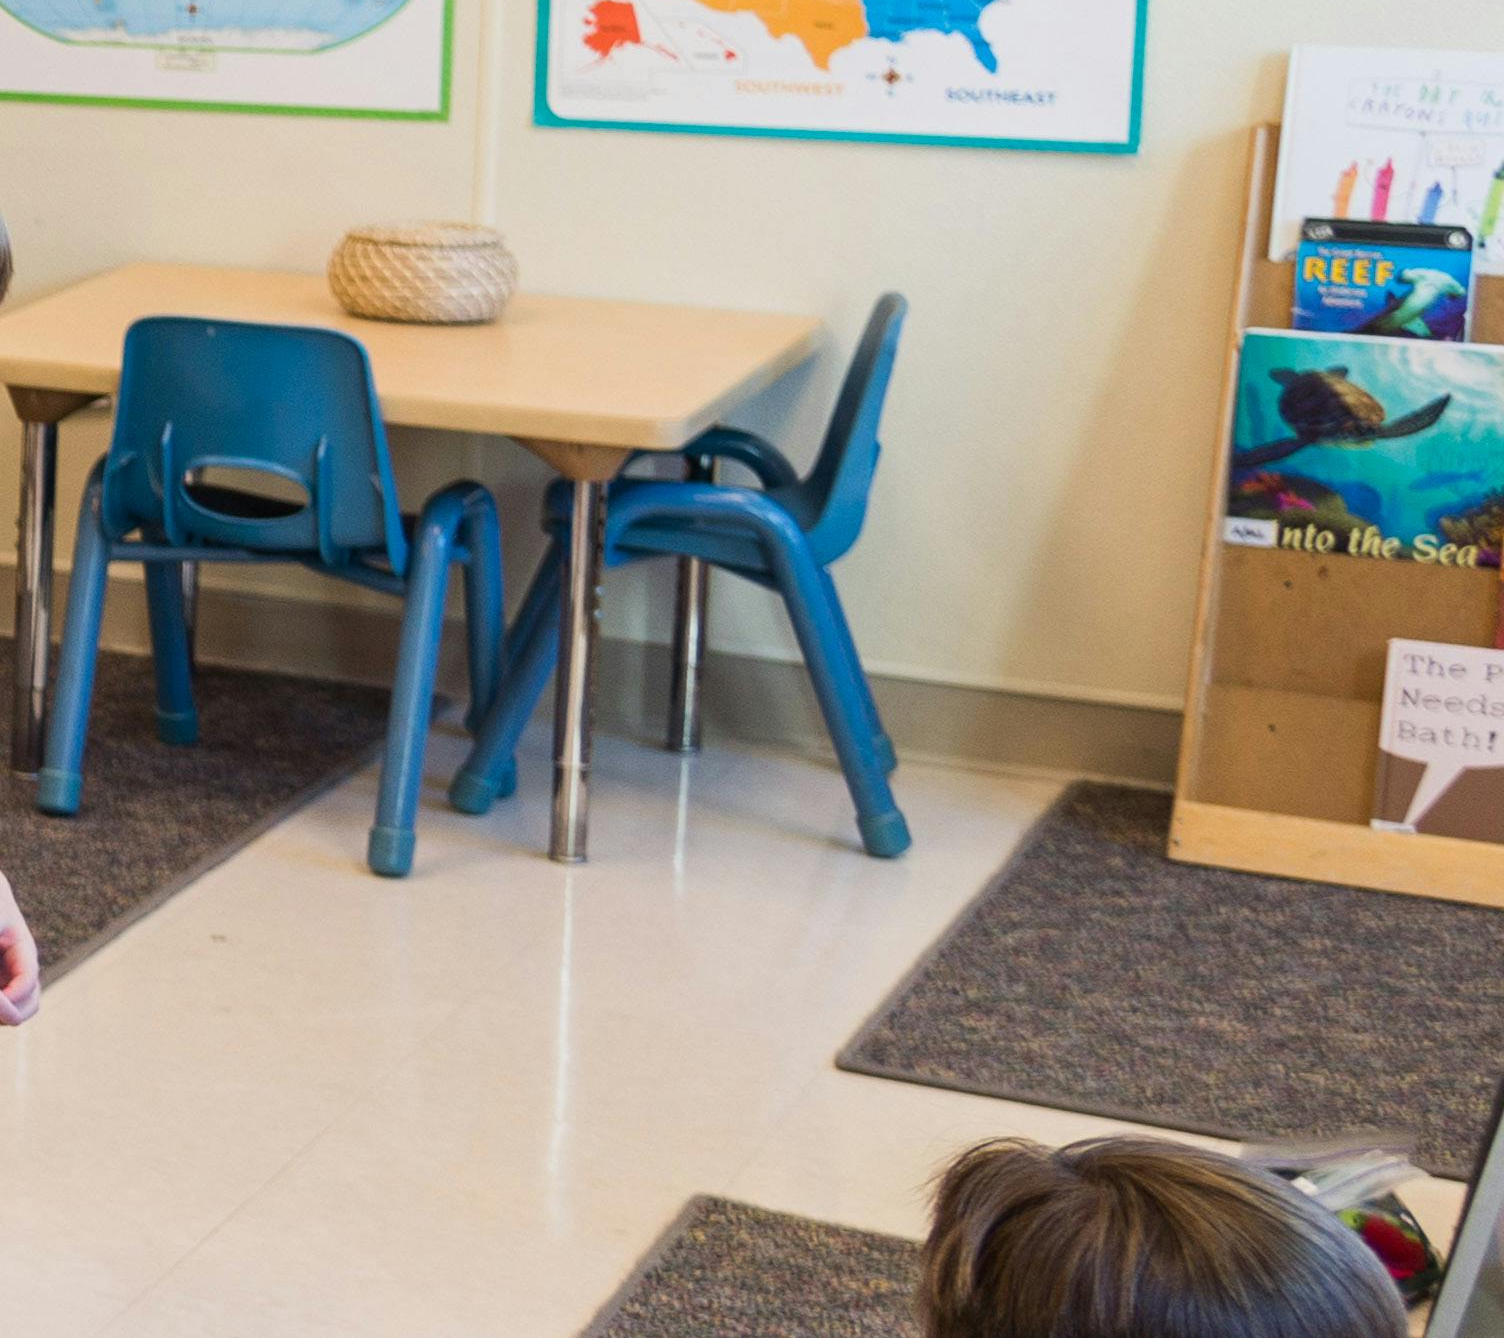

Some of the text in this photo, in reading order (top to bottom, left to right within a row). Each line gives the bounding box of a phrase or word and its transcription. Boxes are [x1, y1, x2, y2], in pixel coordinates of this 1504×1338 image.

[736, 79, 843, 96] SOUTHWEST
[944, 87, 1056, 105] SOUTHEAST
[1303, 255, 1395, 287] REEF
[1281, 522, 1479, 569] nto the Sea
[1404, 652, 1468, 678] The
[1396, 719, 1498, 753] Bath!
